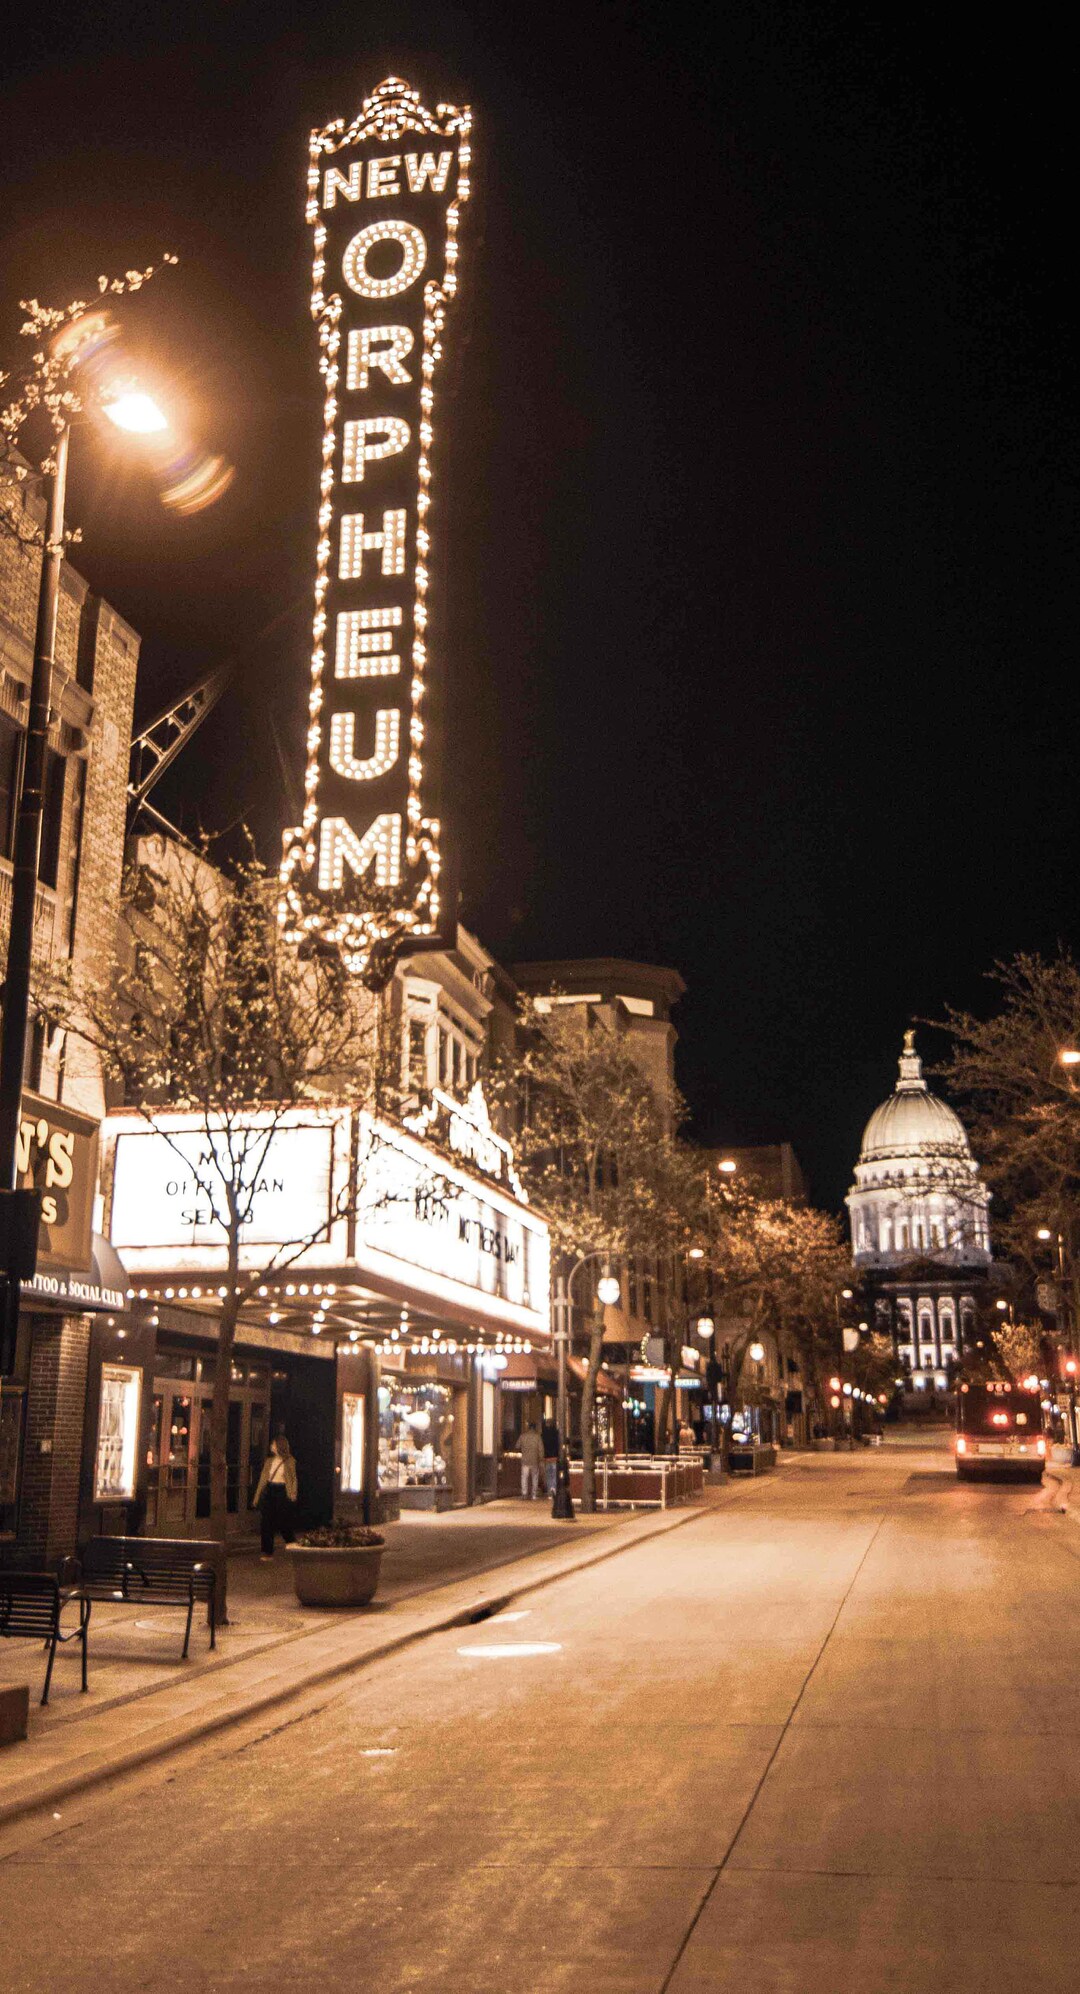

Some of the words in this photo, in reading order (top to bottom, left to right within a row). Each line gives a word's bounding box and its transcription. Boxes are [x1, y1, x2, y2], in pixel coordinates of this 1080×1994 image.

[322, 151, 453, 209] NEW
[317, 219, 428, 891] ORPHEUM
[68, 1280, 101, 1302] SOCIAL
[101, 1287, 124, 1307] CLUB
